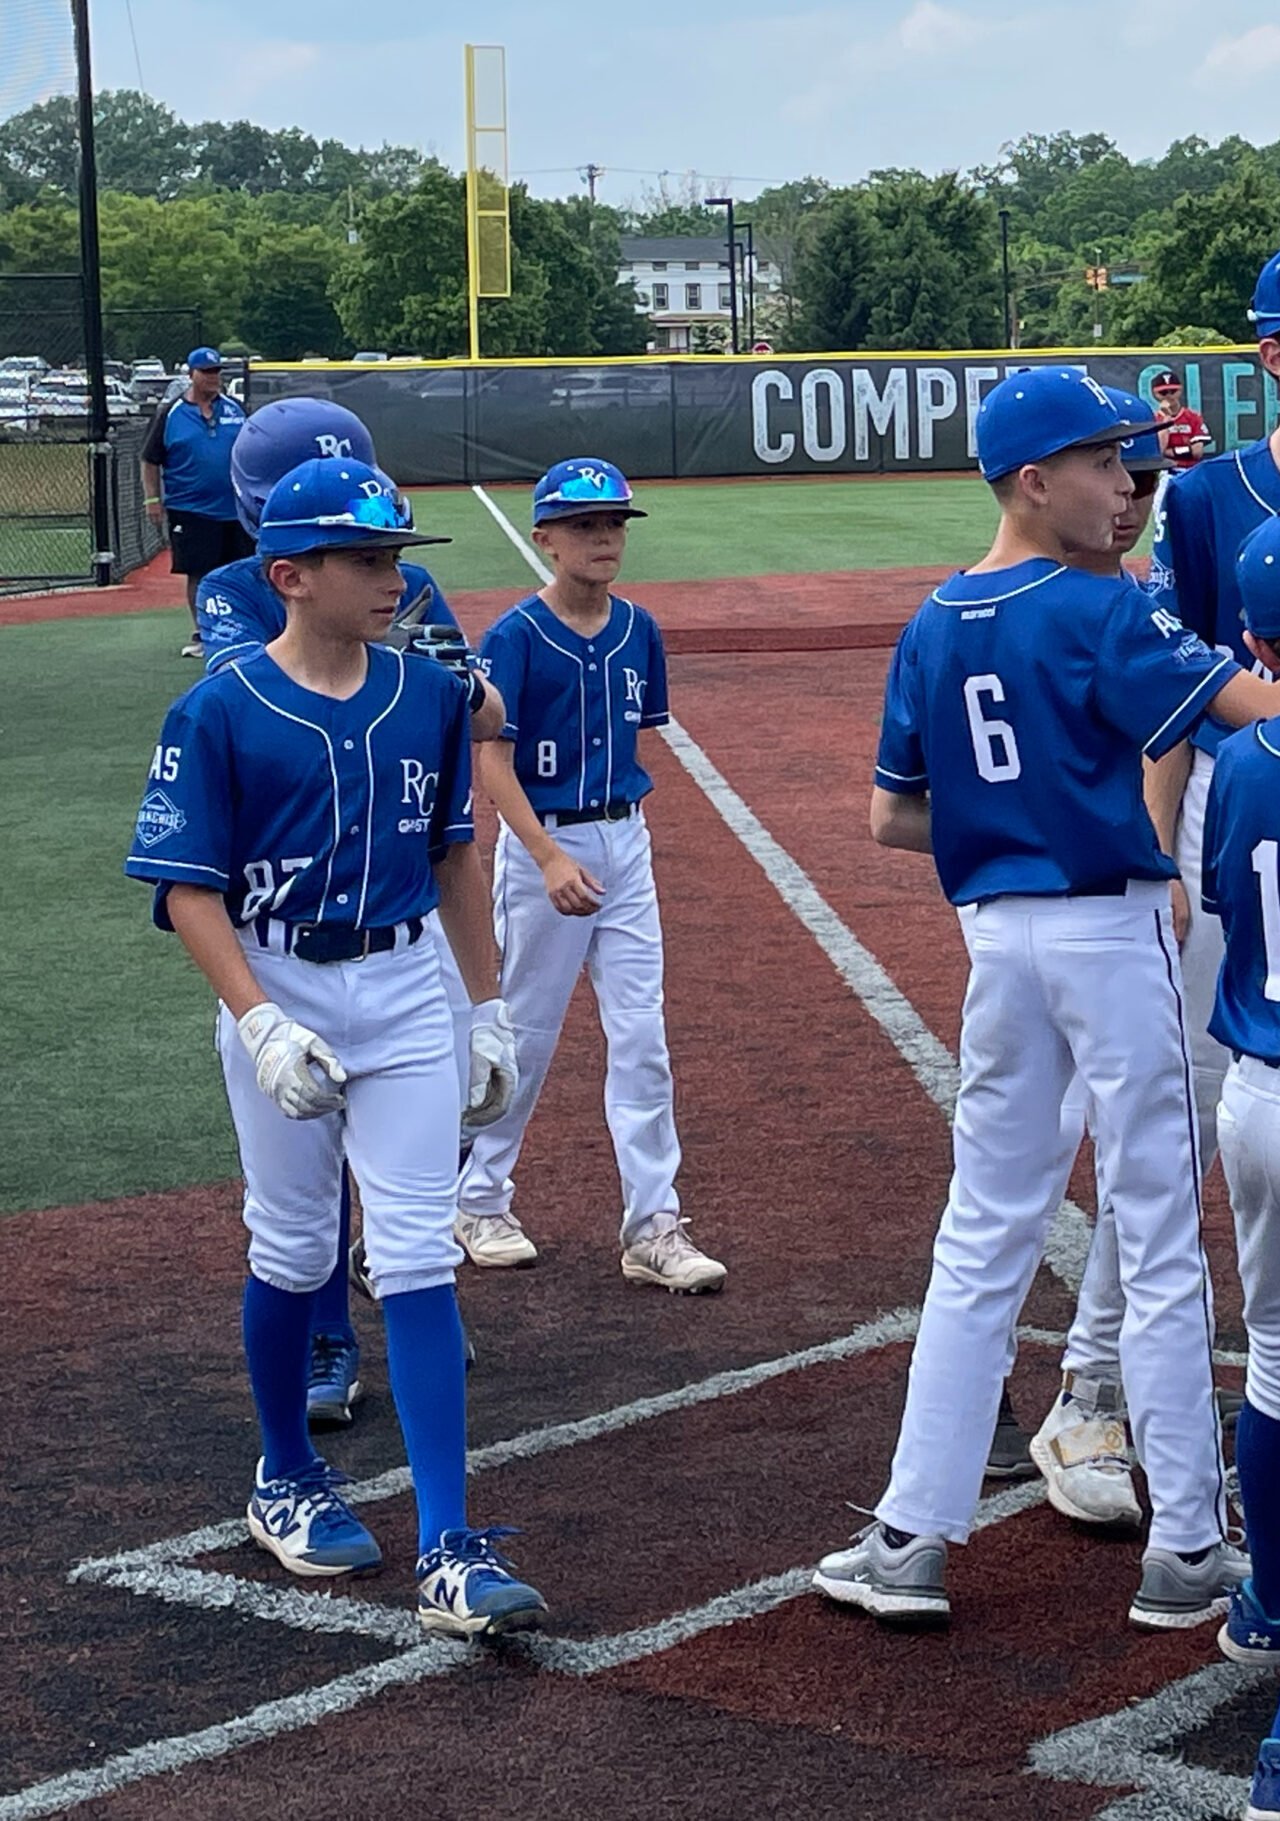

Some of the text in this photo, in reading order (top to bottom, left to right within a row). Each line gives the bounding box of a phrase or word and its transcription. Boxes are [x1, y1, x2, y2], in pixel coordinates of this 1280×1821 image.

[963, 674, 1021, 783] 6
[148, 745, 181, 782] AS
[537, 740, 557, 777] 8
[400, 759, 439, 817] RC
[241, 856, 314, 922] 87
